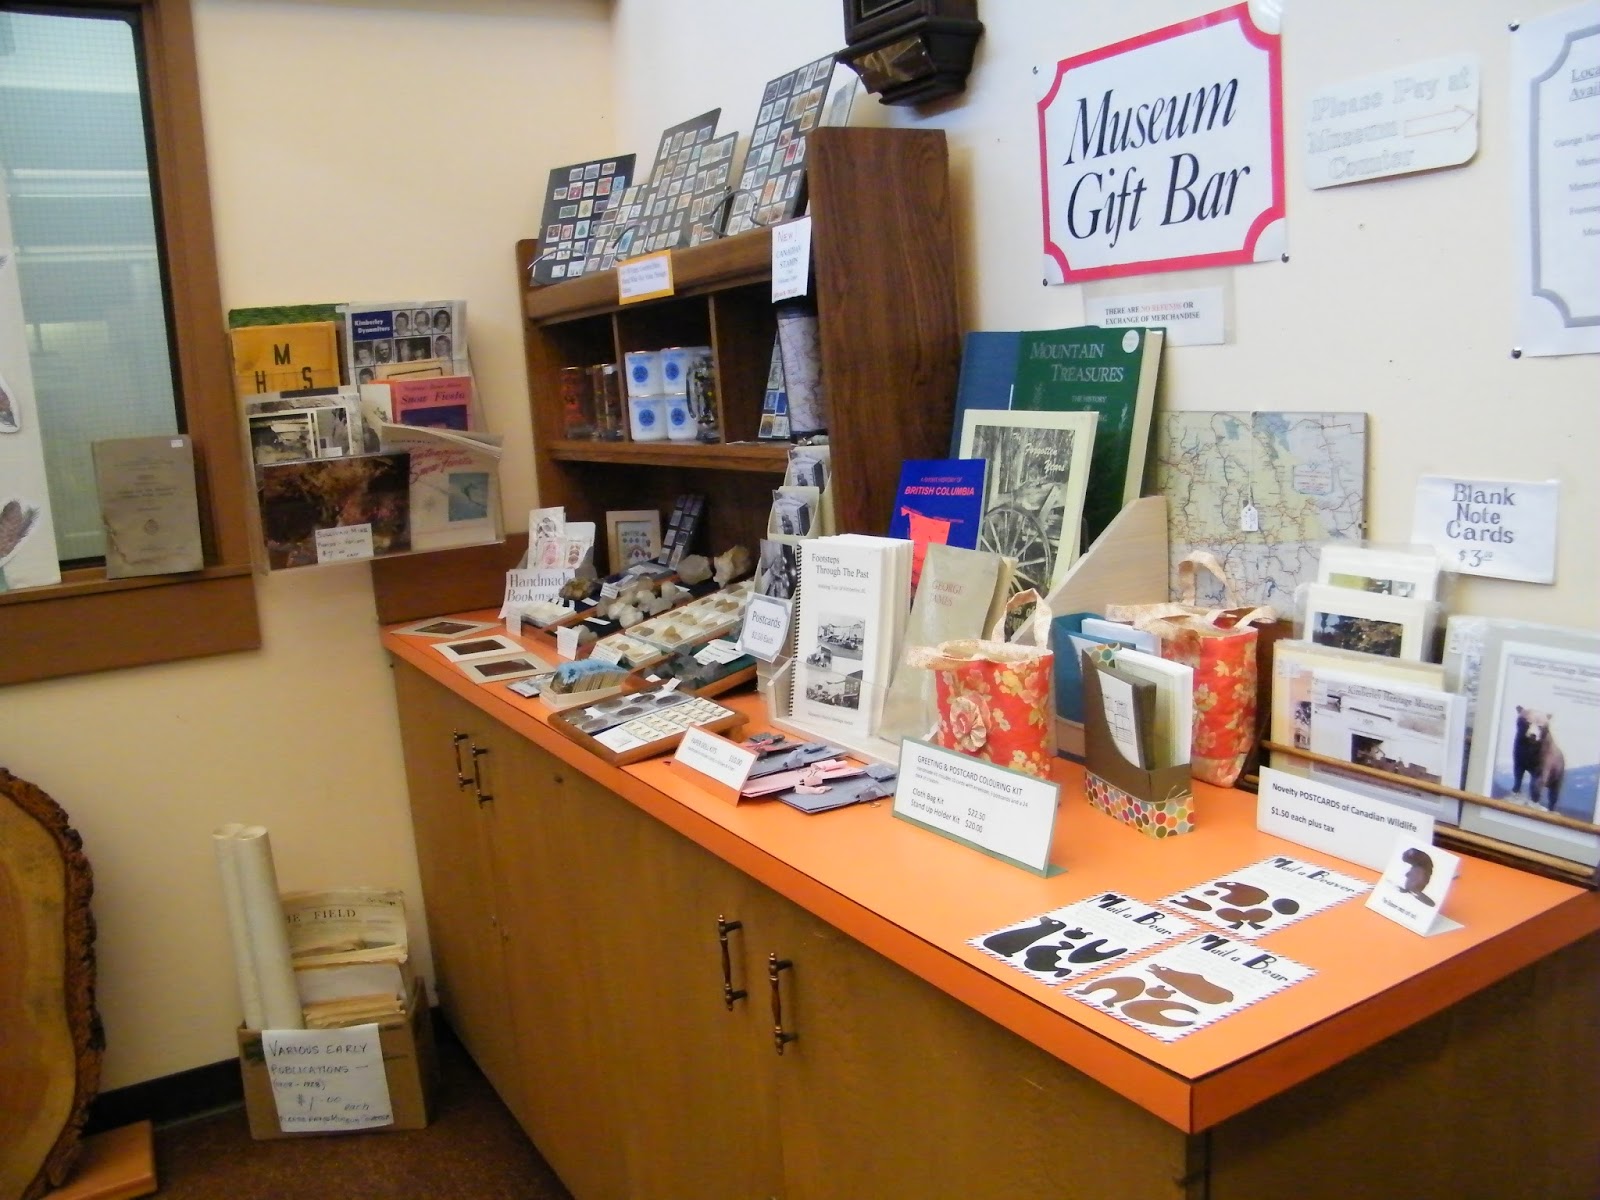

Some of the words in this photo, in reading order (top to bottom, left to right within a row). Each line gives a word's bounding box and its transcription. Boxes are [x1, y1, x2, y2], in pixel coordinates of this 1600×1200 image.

[1312, 91, 1384, 121] Please
[1393, 77, 1440, 104] Pay
[1063, 78, 1238, 166] Museum
[1329, 150, 1415, 179] Counter
[1067, 166, 1147, 249] Gift
[1160, 153, 1251, 226] Bar
[1105, 307, 1125, 315] THERE
[1128, 306, 1139, 314] ARE
[1141, 304, 1150, 312] NO
[1152, 303, 1182, 311] REFUNDS
[1183, 301, 1194, 309] OR
[1105, 316, 1140, 325] EXCHANGE
[1141, 315, 1150, 323] OF
[1151, 312, 1200, 322] MERCHANDISE
[358, 326, 390, 334] Dynamiters
[274, 343, 290, 365] M
[255, 371, 267, 394] H
[302, 366, 313, 389] S
[904, 486, 934, 496] BRITISH
[935, 486, 975, 496] COLUMBIA
[1452, 483, 1516, 506] Blank
[1456, 503, 1501, 525] Note
[1446, 520, 1514, 544] Cards
[812, 553, 840, 565] Footsteps
[816, 565, 841, 578] Through
[843, 567, 854, 578] The
[856, 569, 869, 578] Past
[932, 580, 964, 595] GEORGE
[752, 611, 781, 628] Postcards
[1348, 685, 1381, 699] Kimberley
[1384, 692, 1412, 707] Heritage
[1415, 698, 1443, 711] Museum
[918, 755, 943, 769] GREETING
[944, 763, 947, 771] &
[950, 766, 978, 781] POSTCARD
[979, 775, 1011, 793] COLOURING
[1012, 787, 1023, 796] KIT
[911, 799, 925, 811] Stand
[926, 806, 933, 814] Up
[934, 808, 951, 819] Holder
[952, 815, 960, 824] Kit
[965, 819, 983, 833] $20.00
[913, 788, 925, 798] Cloth
[927, 793, 936, 804] Bag
[968, 808, 986, 821] $22.50
[1272, 783, 1298, 797] Novelty
[1300, 791, 1340, 810] POSTCARDS
[1342, 802, 1349, 811] of
[1351, 807, 1385, 822] Canadian
[1387, 817, 1417, 832] Wildlife
[1271, 807, 1289, 819] $1.50
[1291, 814, 1306, 824] each
[1308, 818, 1322, 829] plus
[1324, 824, 1335, 832] tax
[1264, 857, 1303, 872] Mail
[1307, 870, 1355, 892] Beaver
[314, 909, 356, 919] FIELD
[1087, 893, 1131, 915] Mail
[1132, 911, 1172, 935] Bear
[1188, 934, 1238, 957] Mail
[1242, 953, 1288, 981] Bear
[269, 1040, 319, 1057] VARIOUS
[326, 1043, 367, 1054] EARLY
[271, 1064, 349, 1075] PUBLICATIONS
